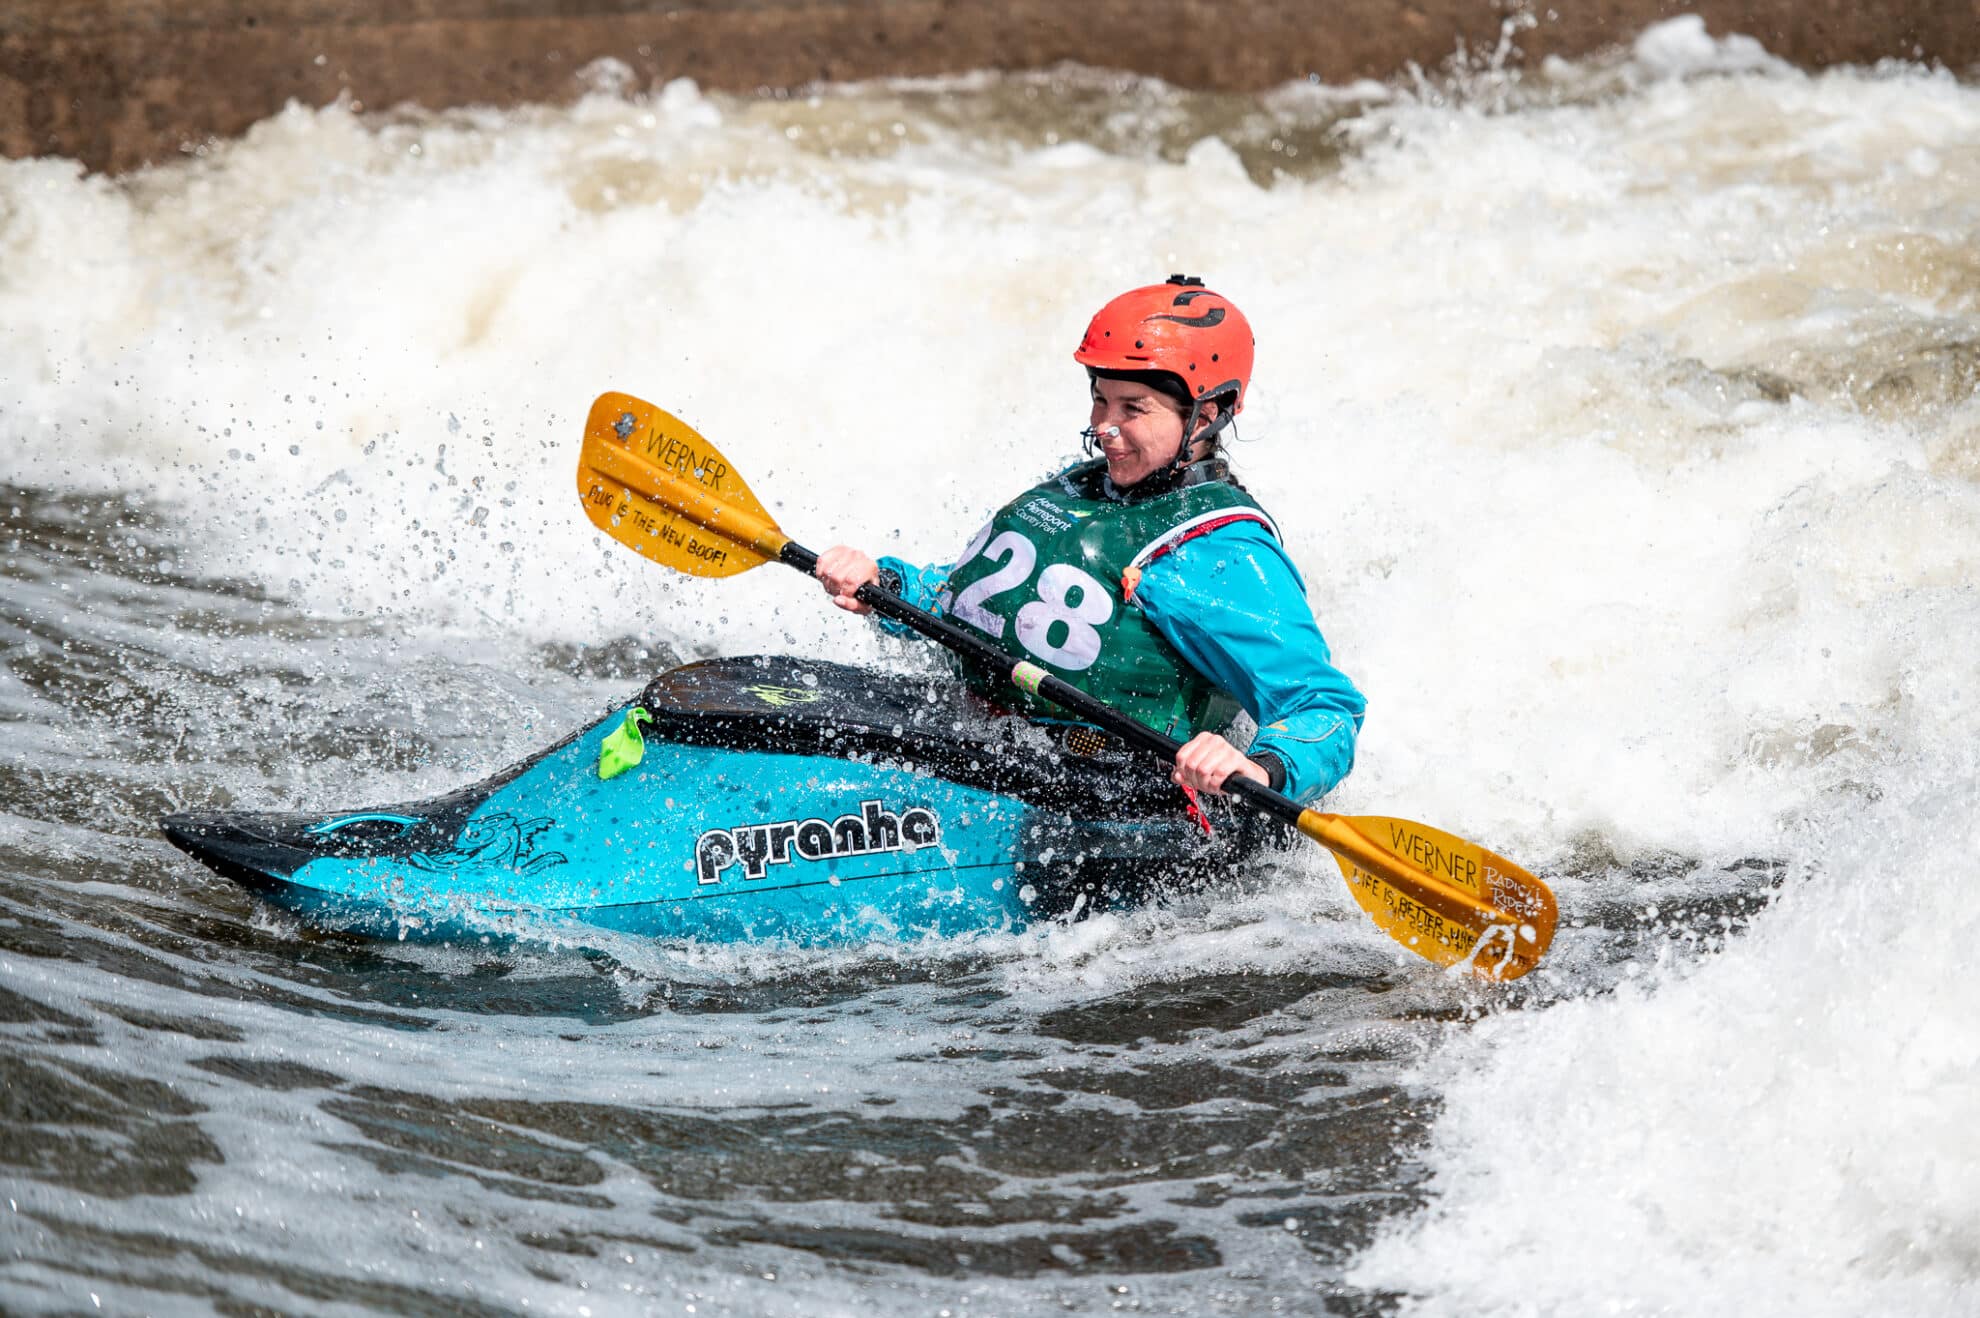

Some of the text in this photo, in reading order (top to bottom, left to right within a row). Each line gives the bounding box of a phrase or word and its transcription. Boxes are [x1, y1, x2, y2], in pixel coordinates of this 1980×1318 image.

[647, 428, 727, 490] WERNER
[588, 485, 727, 567] PLUG IS THE NEW BOOF!
[1014, 506, 1058, 536] Country Park
[1023, 501, 1072, 531] Pierrepont
[695, 799, 940, 885] pyranha
[1390, 821, 1477, 888] WERNER
[1353, 867, 1379, 897] LIFE
[1383, 887, 1394, 906] IS
[1399, 896, 1444, 932] BETTER
[1450, 926, 1481, 947] WHE
